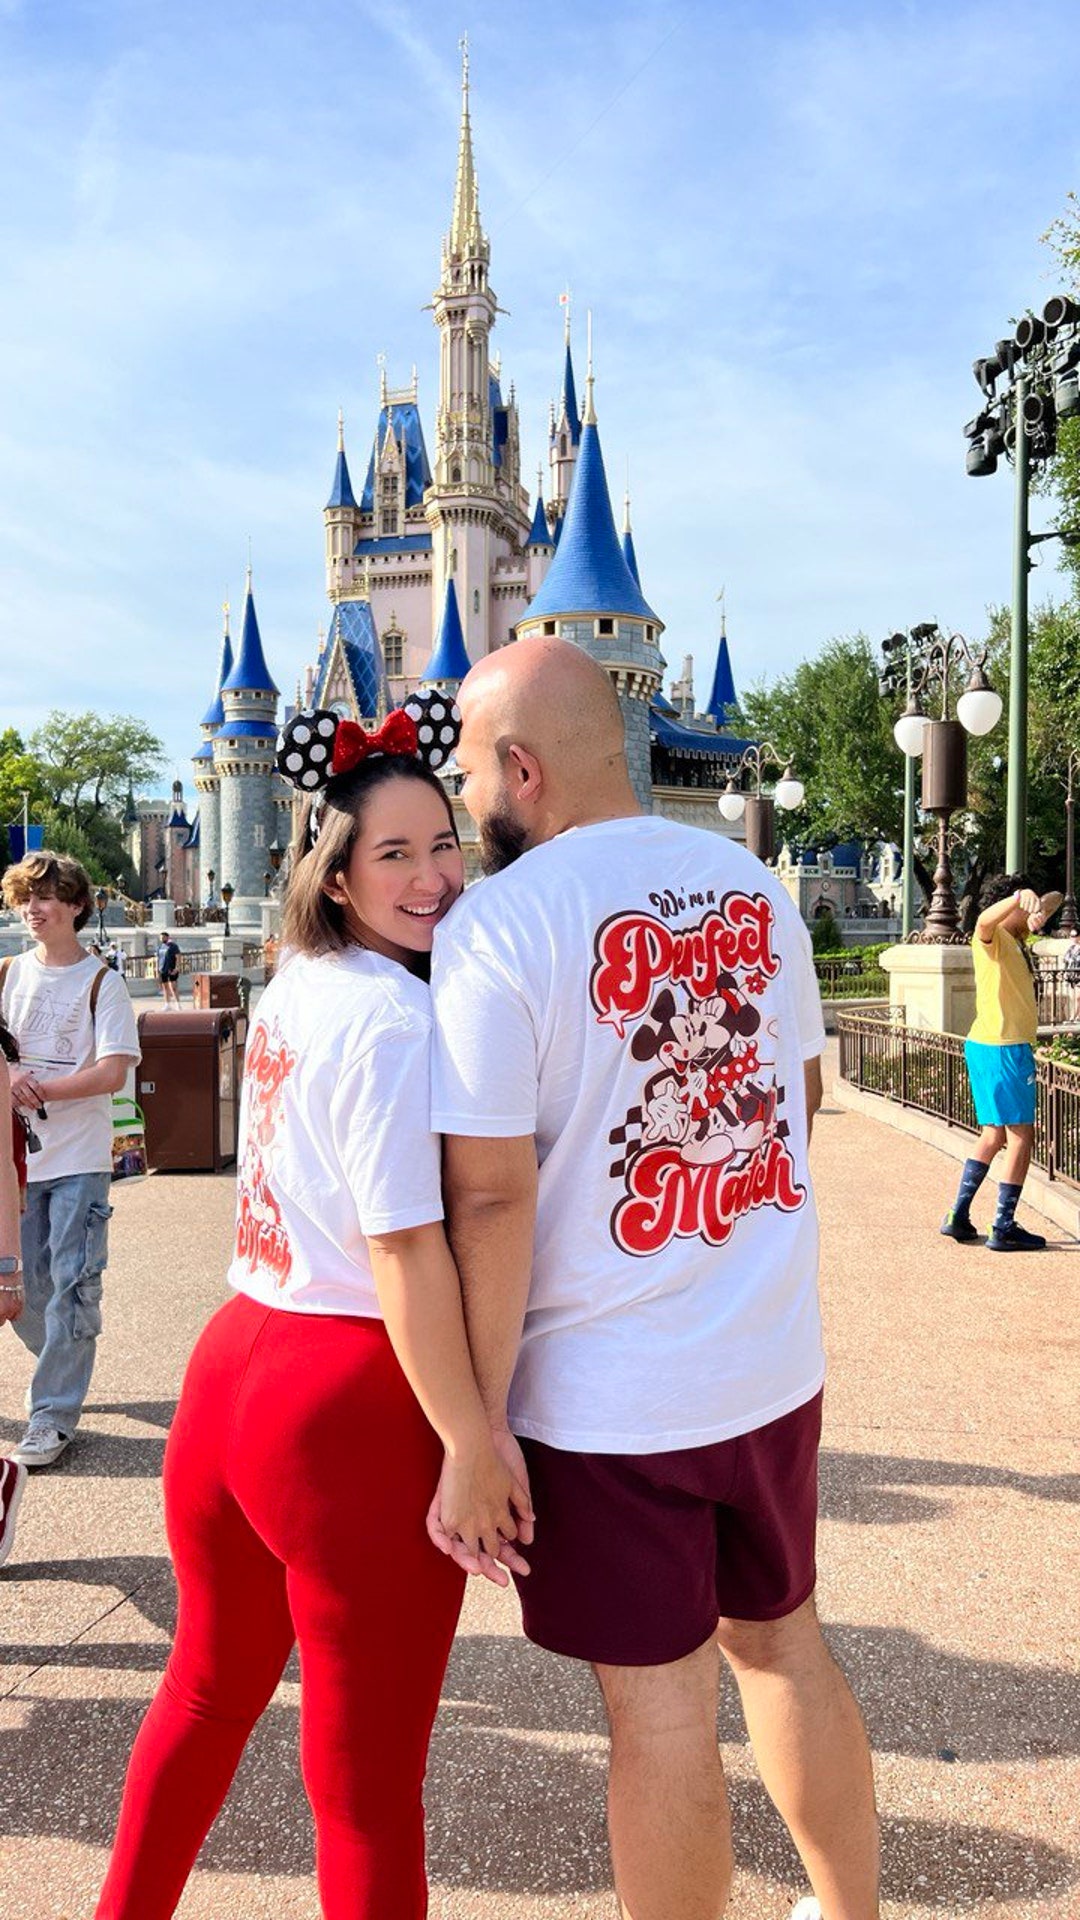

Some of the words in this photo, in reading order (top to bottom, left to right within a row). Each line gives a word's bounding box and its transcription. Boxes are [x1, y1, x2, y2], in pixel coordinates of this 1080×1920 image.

[588, 890, 781, 1022] Perfect
[648, 886, 705, 918] We're
[609, 1138, 806, 1258] Match
